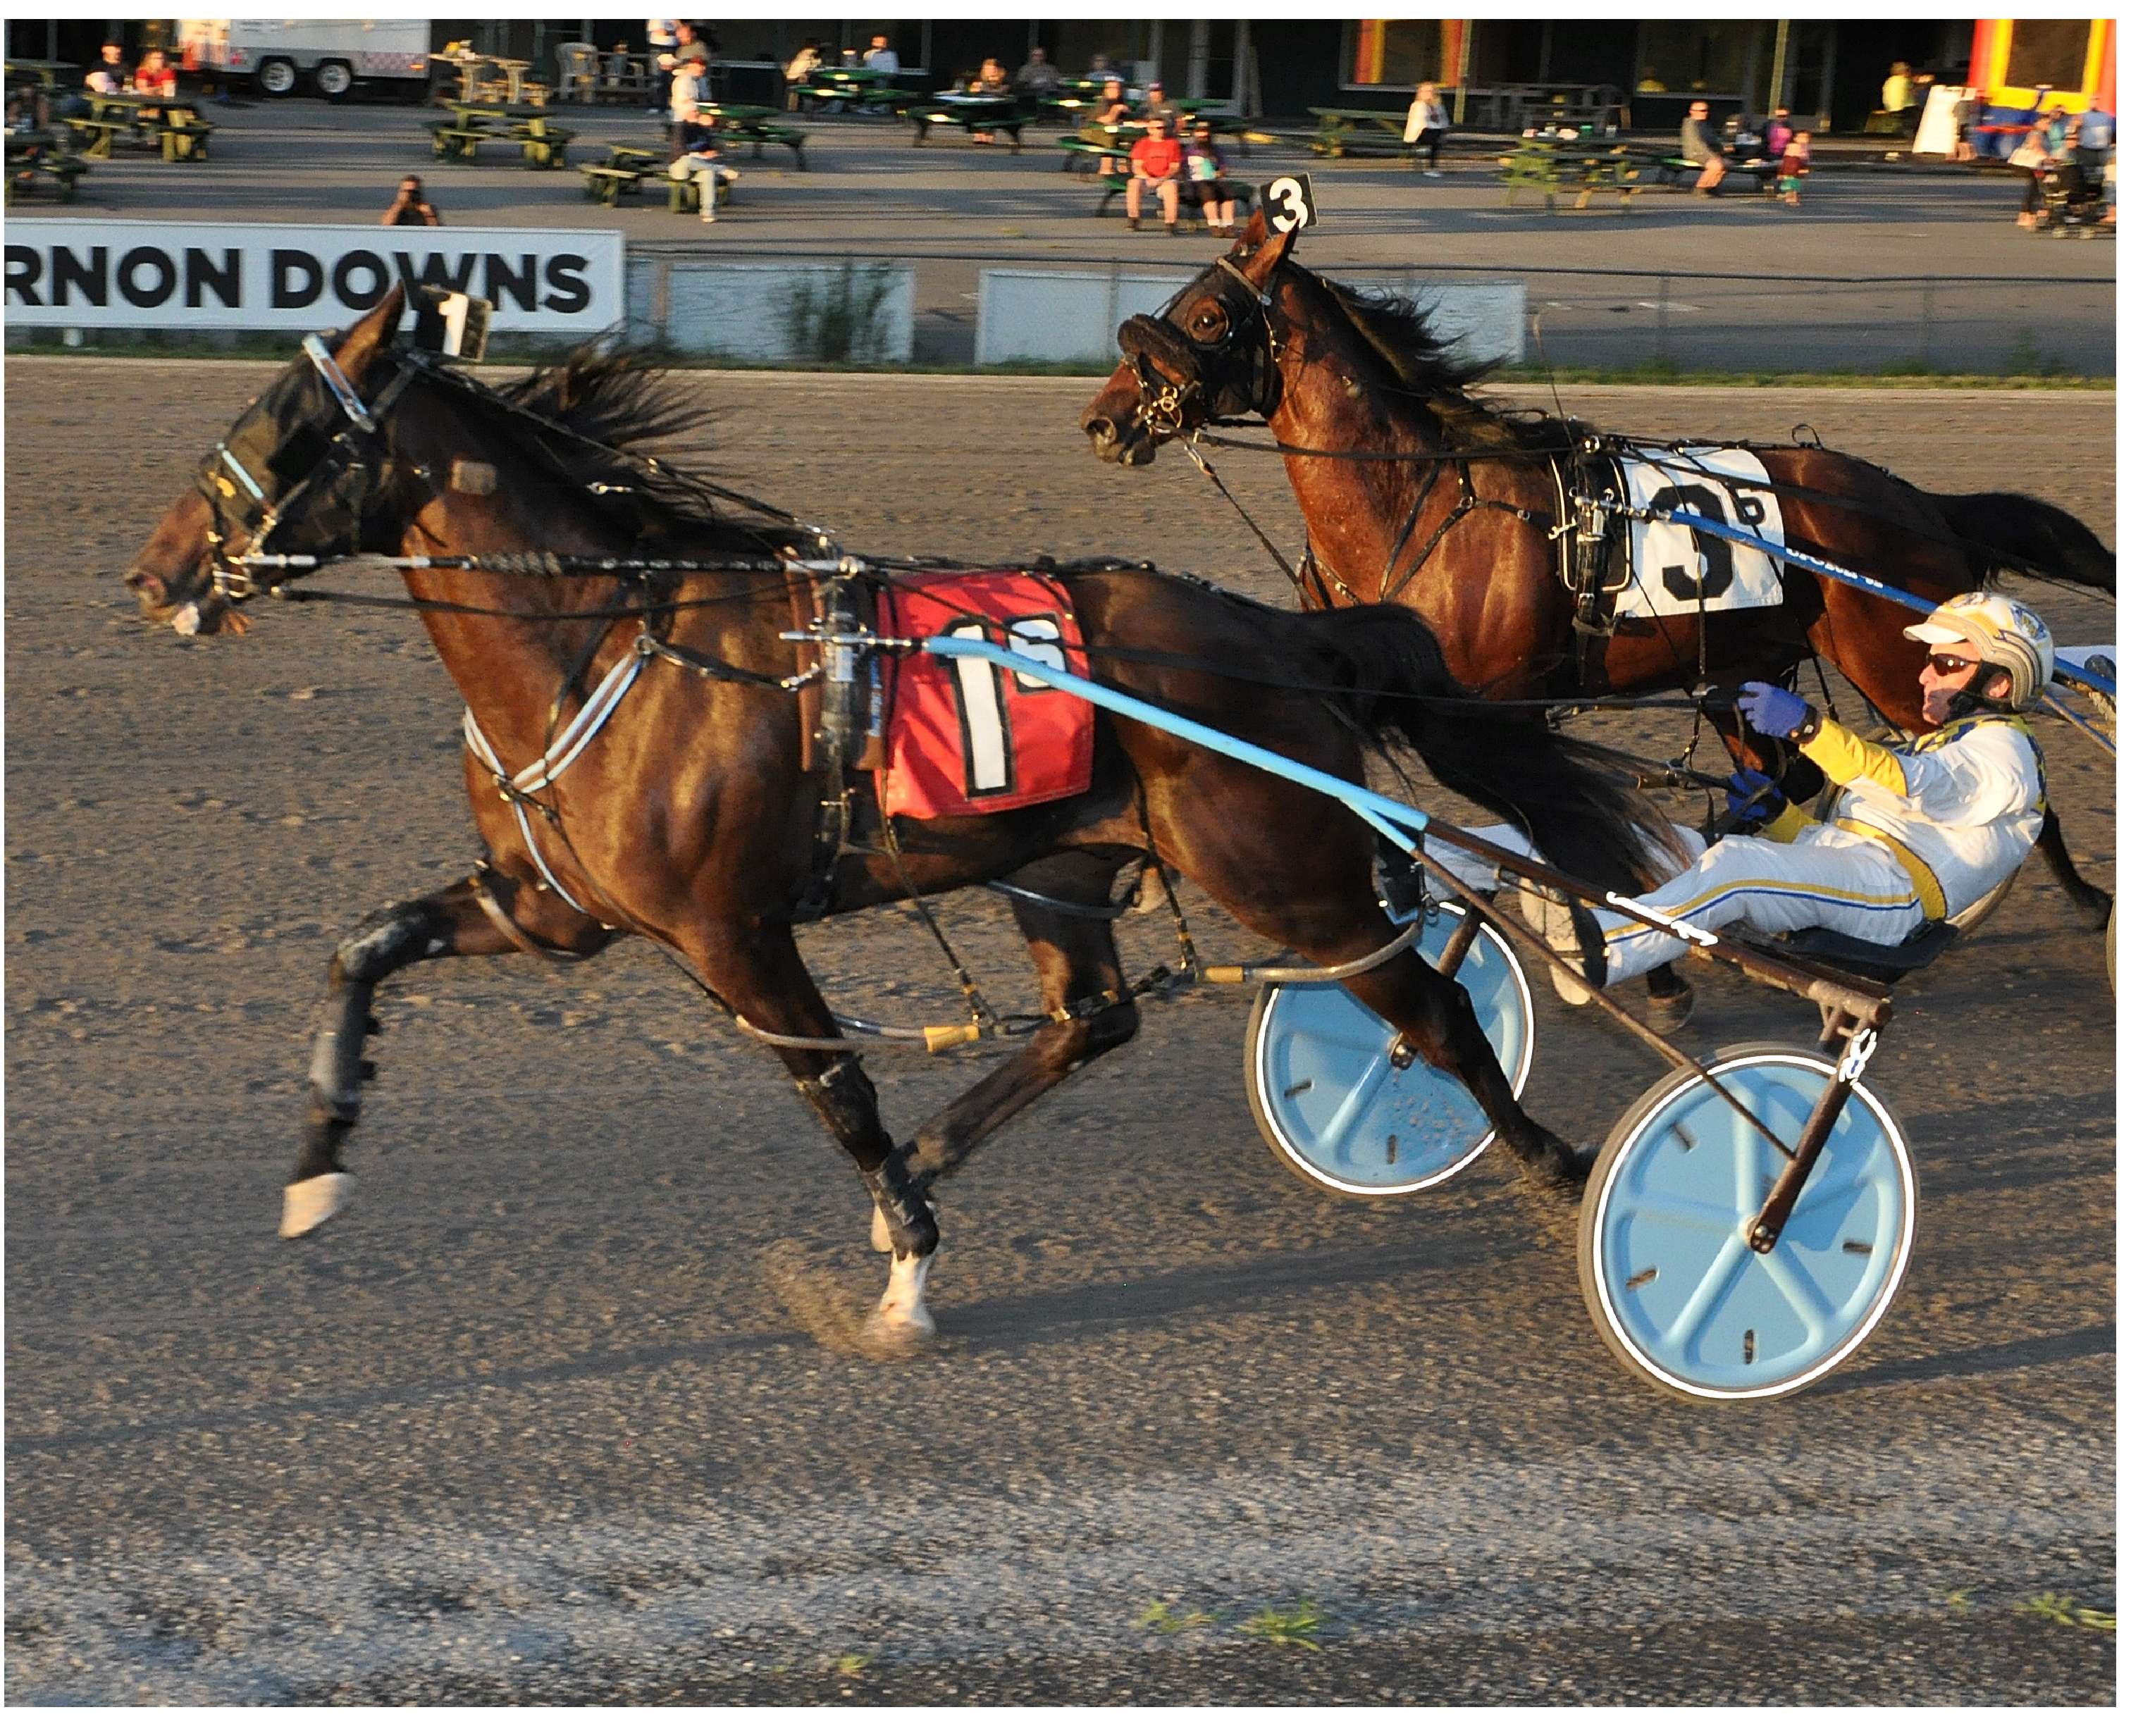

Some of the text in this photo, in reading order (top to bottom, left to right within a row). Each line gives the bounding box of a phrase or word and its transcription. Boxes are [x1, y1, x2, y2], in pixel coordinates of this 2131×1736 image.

[1269, 177, 1308, 233] 3
[4, 245, 591, 314] RNON DOWNS
[438, 293, 468, 356] 1
